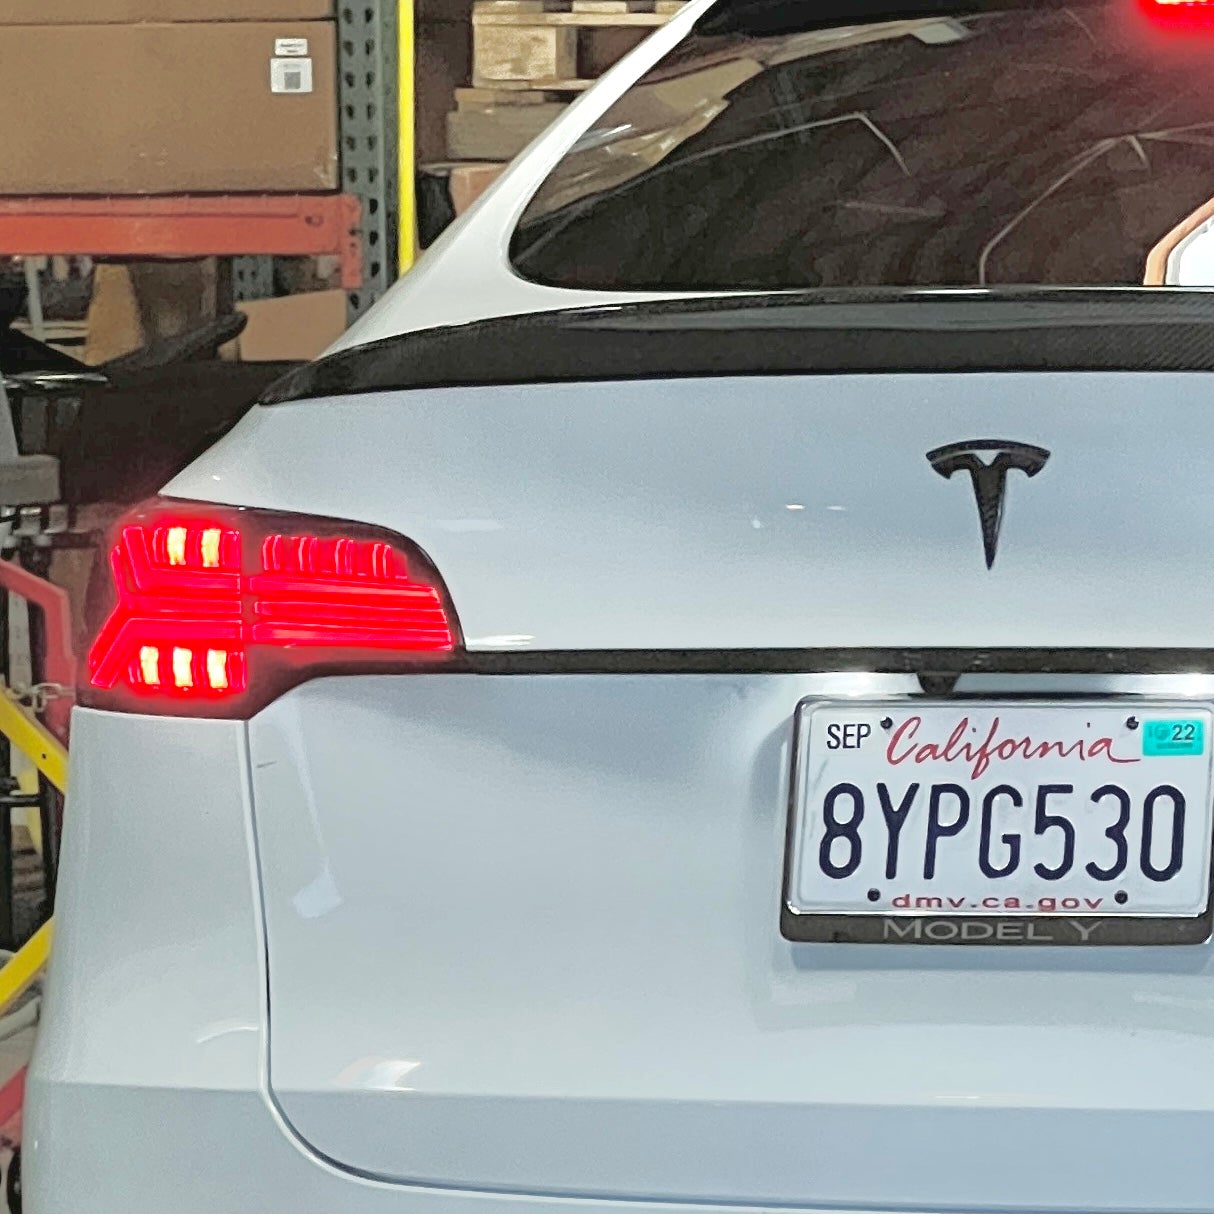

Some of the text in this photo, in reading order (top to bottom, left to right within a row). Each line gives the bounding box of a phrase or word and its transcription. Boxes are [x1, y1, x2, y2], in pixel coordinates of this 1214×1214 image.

[826, 723, 872, 750] SEP
[1171, 723, 1195, 741] 22
[886, 716, 1141, 780] California
[818, 782, 1186, 882] 8YPG530
[891, 894, 1104, 912] dmv.ca.gov
[883, 919, 1102, 941] MODEL Y
